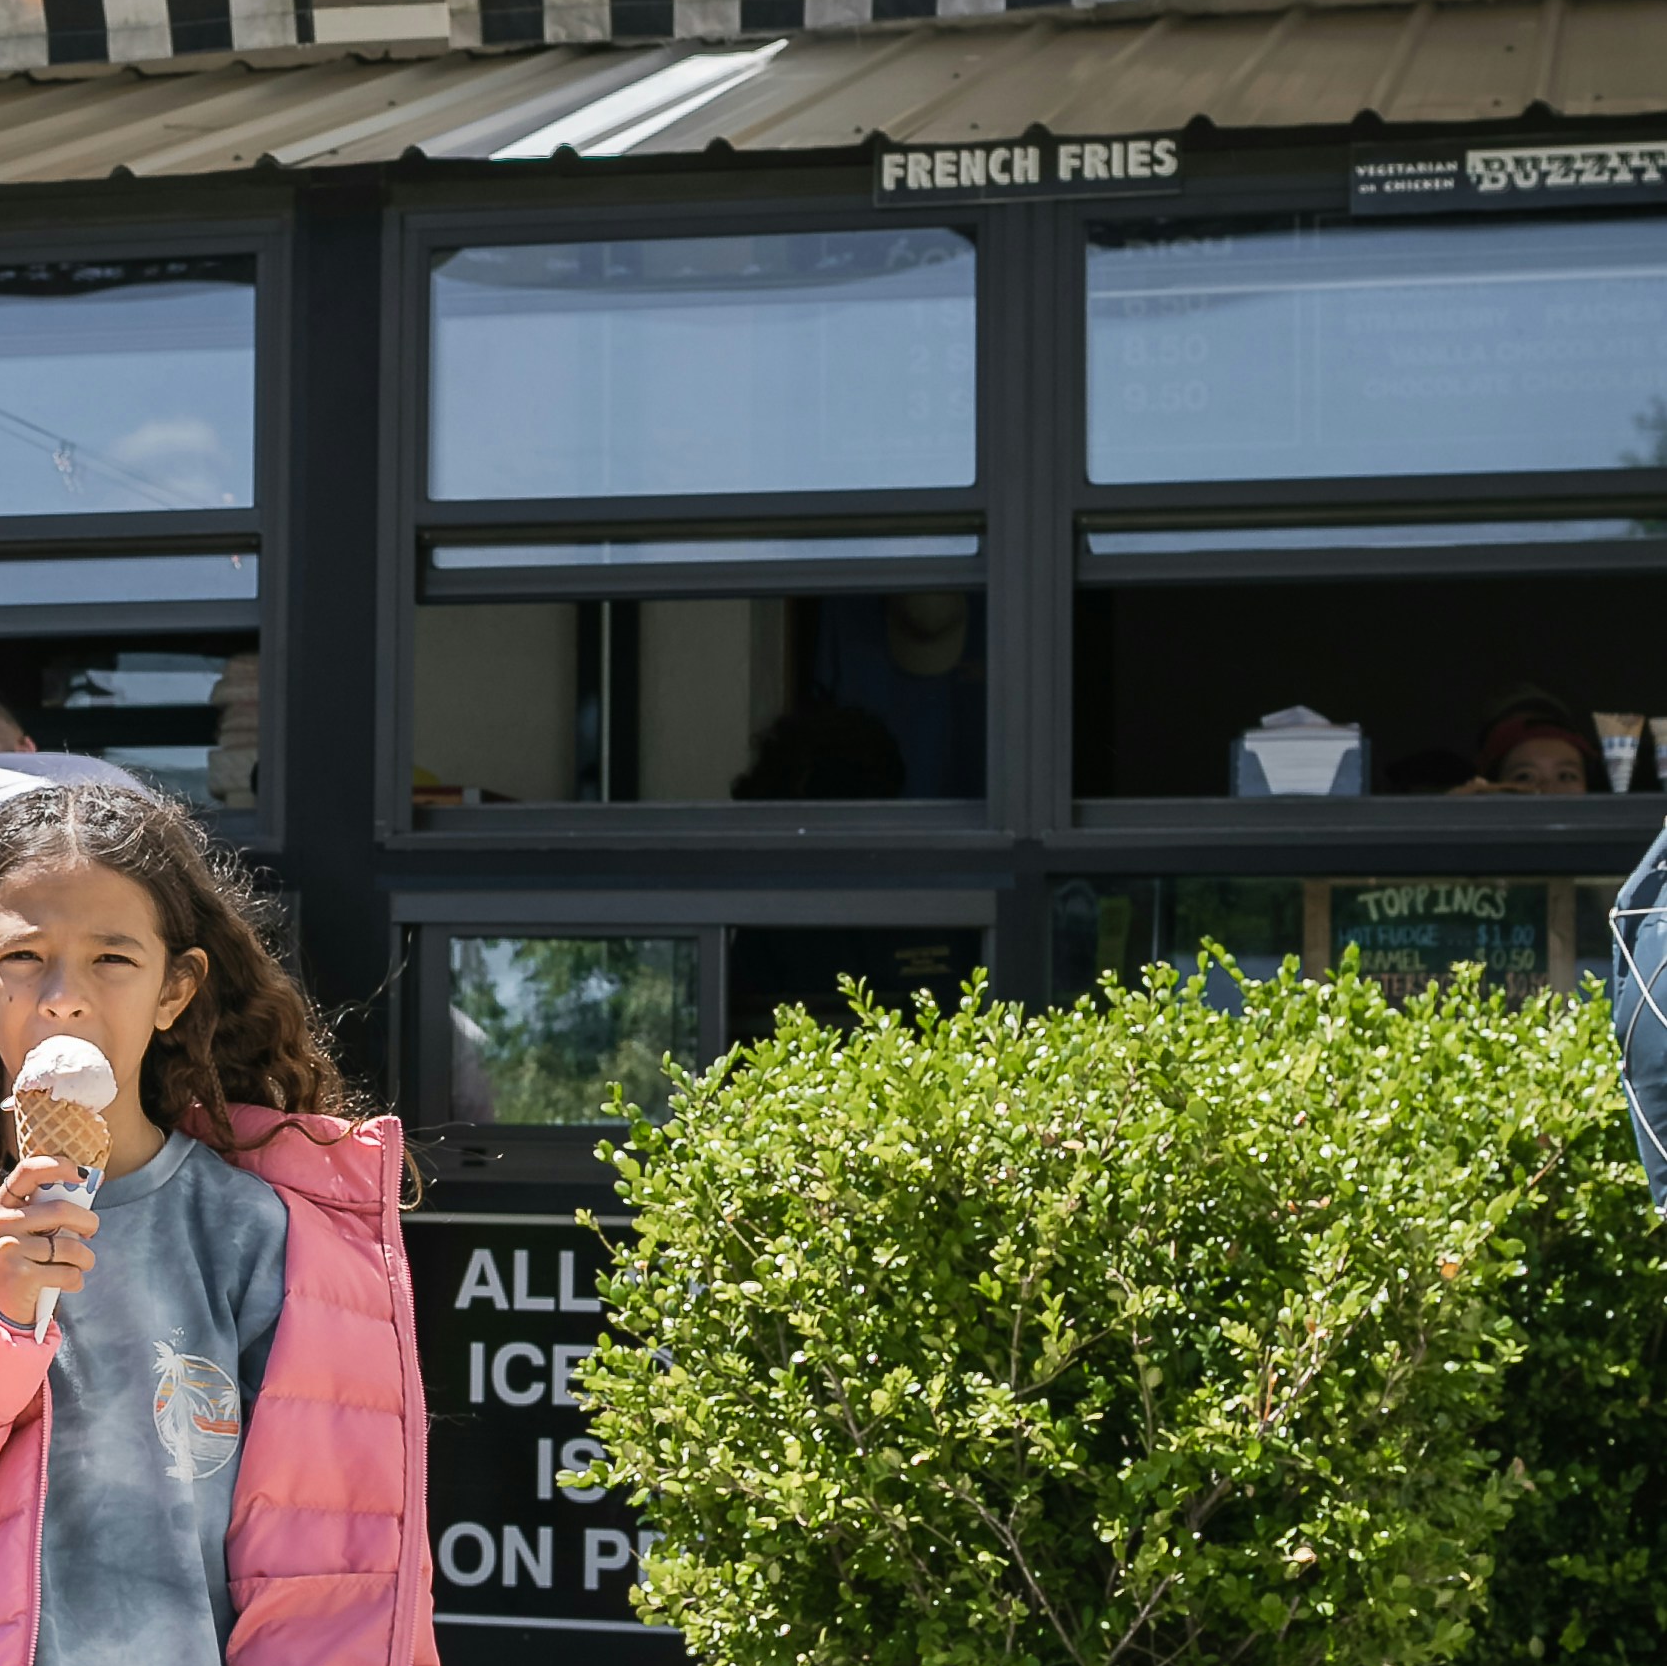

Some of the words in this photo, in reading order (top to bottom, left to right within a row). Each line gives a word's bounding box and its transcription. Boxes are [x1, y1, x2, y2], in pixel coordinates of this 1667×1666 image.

[881, 147, 1040, 191] FRENCH
[1058, 140, 1178, 182] FRIES
[1357, 884, 1507, 921] TOPPINGS
[1360, 947, 1427, 971] RAMEL
[1376, 923, 1441, 947] FUDGE
[455, 1249, 601, 1312] ALL
[537, 1438, 608, 1503] IS
[438, 1522, 553, 1589] ON
